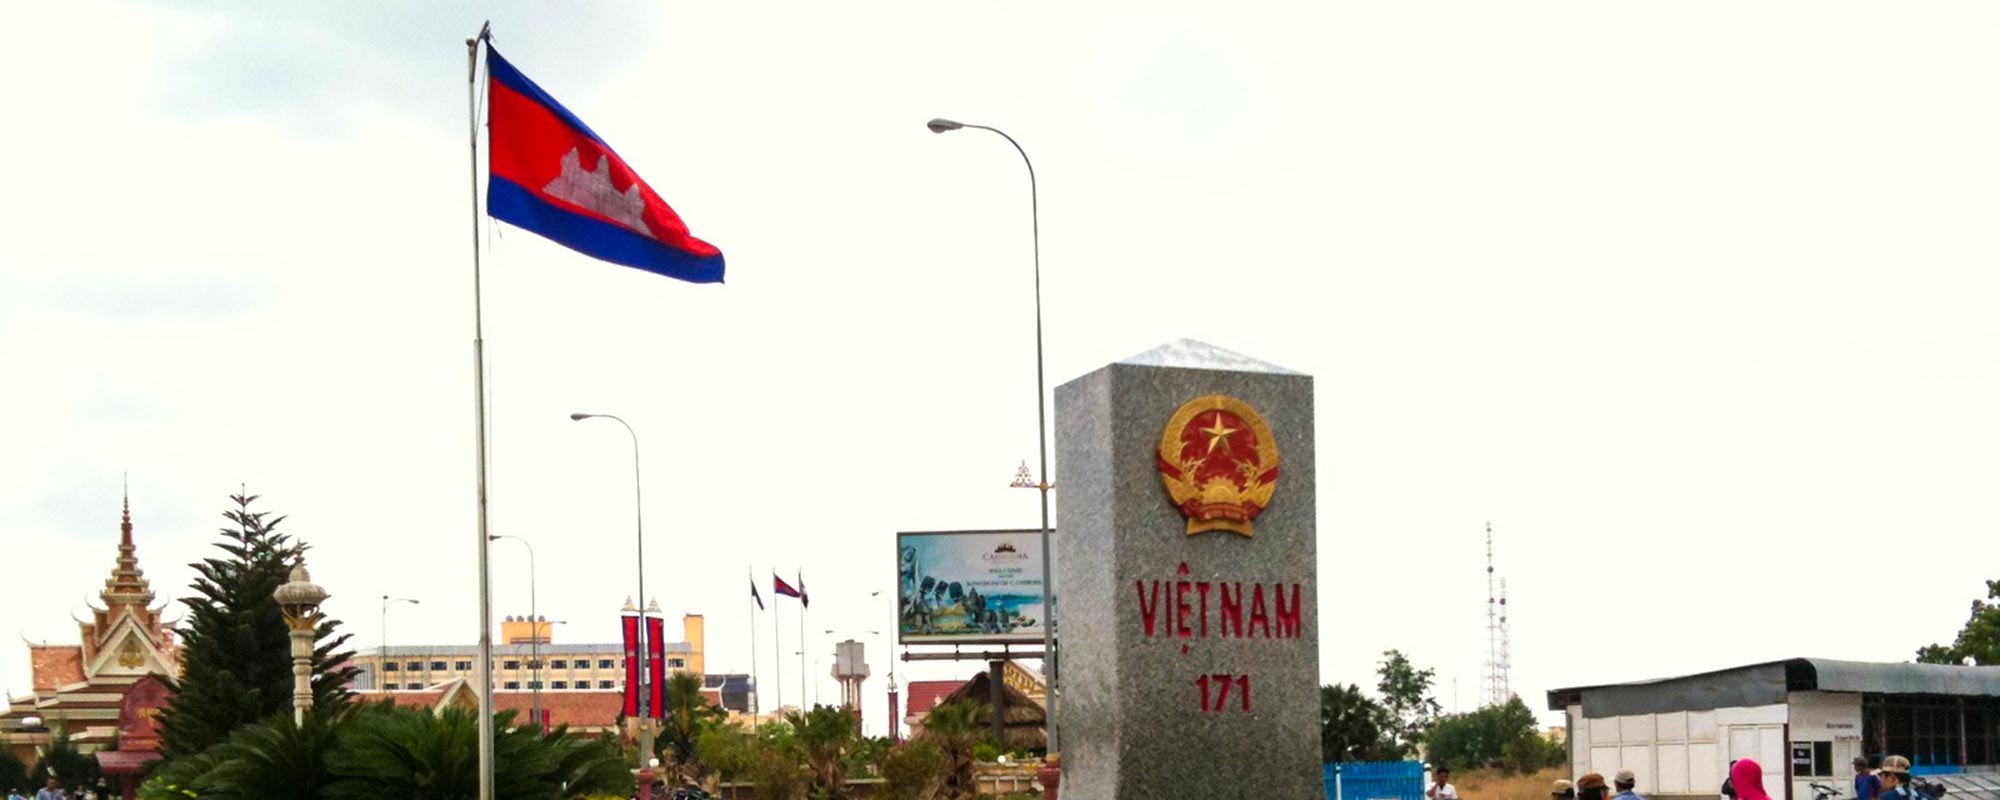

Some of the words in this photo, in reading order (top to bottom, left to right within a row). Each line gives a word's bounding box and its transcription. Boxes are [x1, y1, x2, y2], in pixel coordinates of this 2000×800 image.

[982, 553, 1029, 561] CAMDIA
[1136, 561, 1210, 655] VIỆT
[1220, 581, 1301, 640] NAM
[1195, 673, 1250, 713] 171
